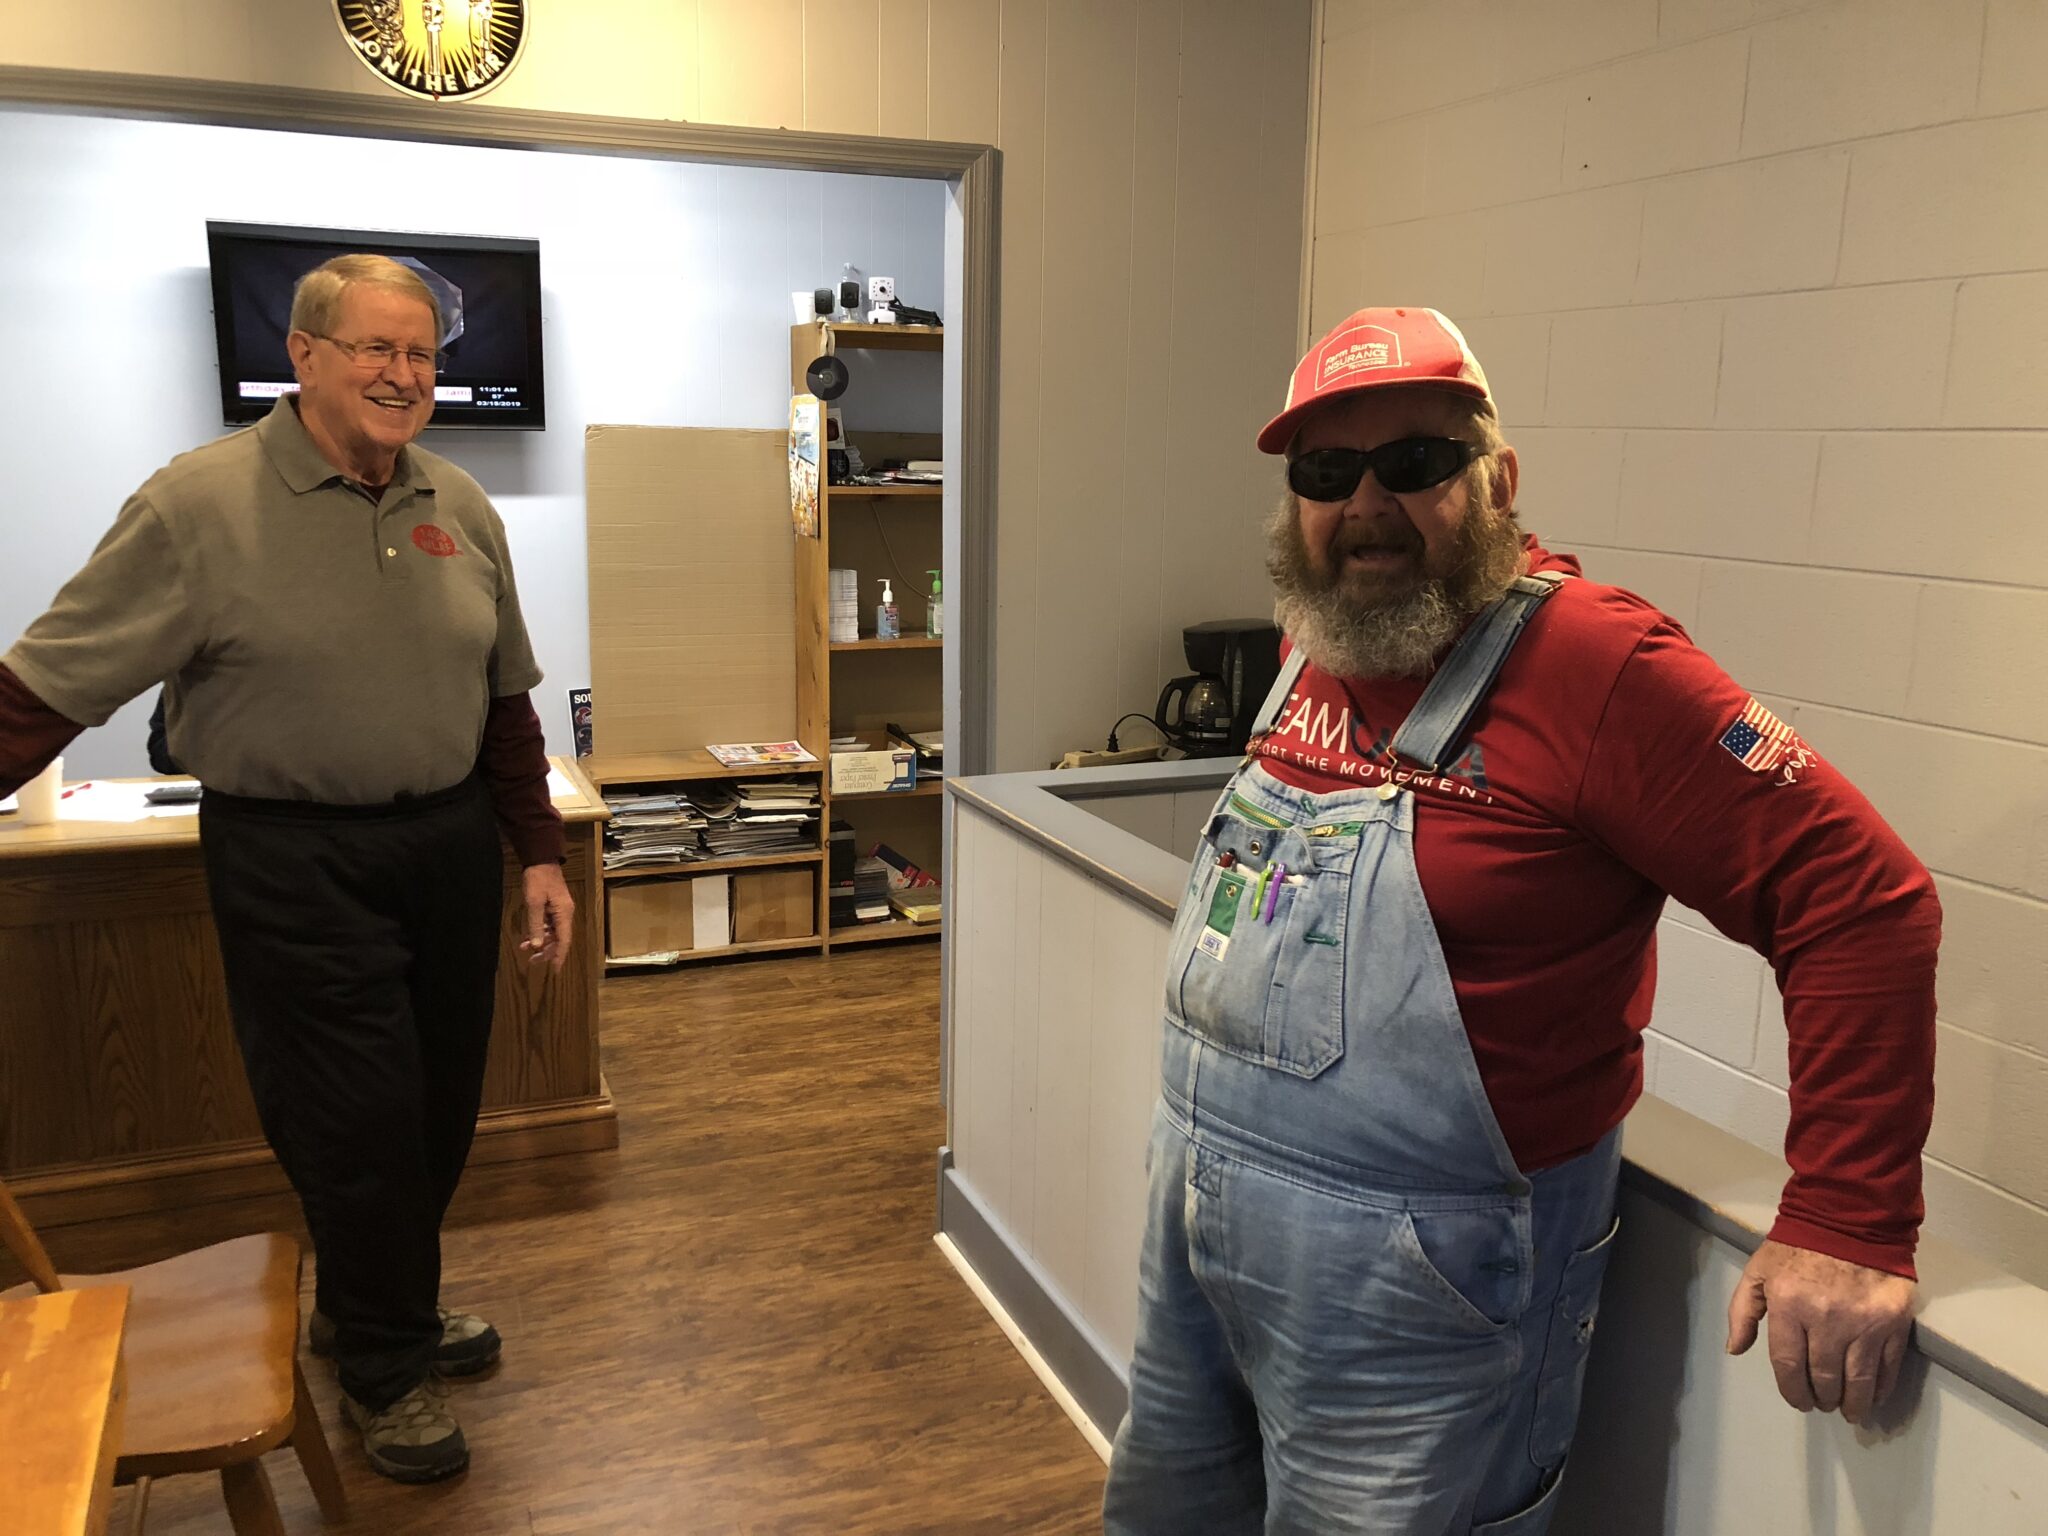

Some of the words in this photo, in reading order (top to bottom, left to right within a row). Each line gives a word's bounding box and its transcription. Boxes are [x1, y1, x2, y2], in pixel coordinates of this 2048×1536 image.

[364, 40, 401, 77] ON
[410, 69, 459, 92] THE
[467, 53, 506, 89] AIR
[1324, 349, 1389, 375] INSURANCE
[1325, 350, 1348, 366] Farm
[1350, 343, 1389, 353] Bureau
[1296, 752, 1330, 771] THE
